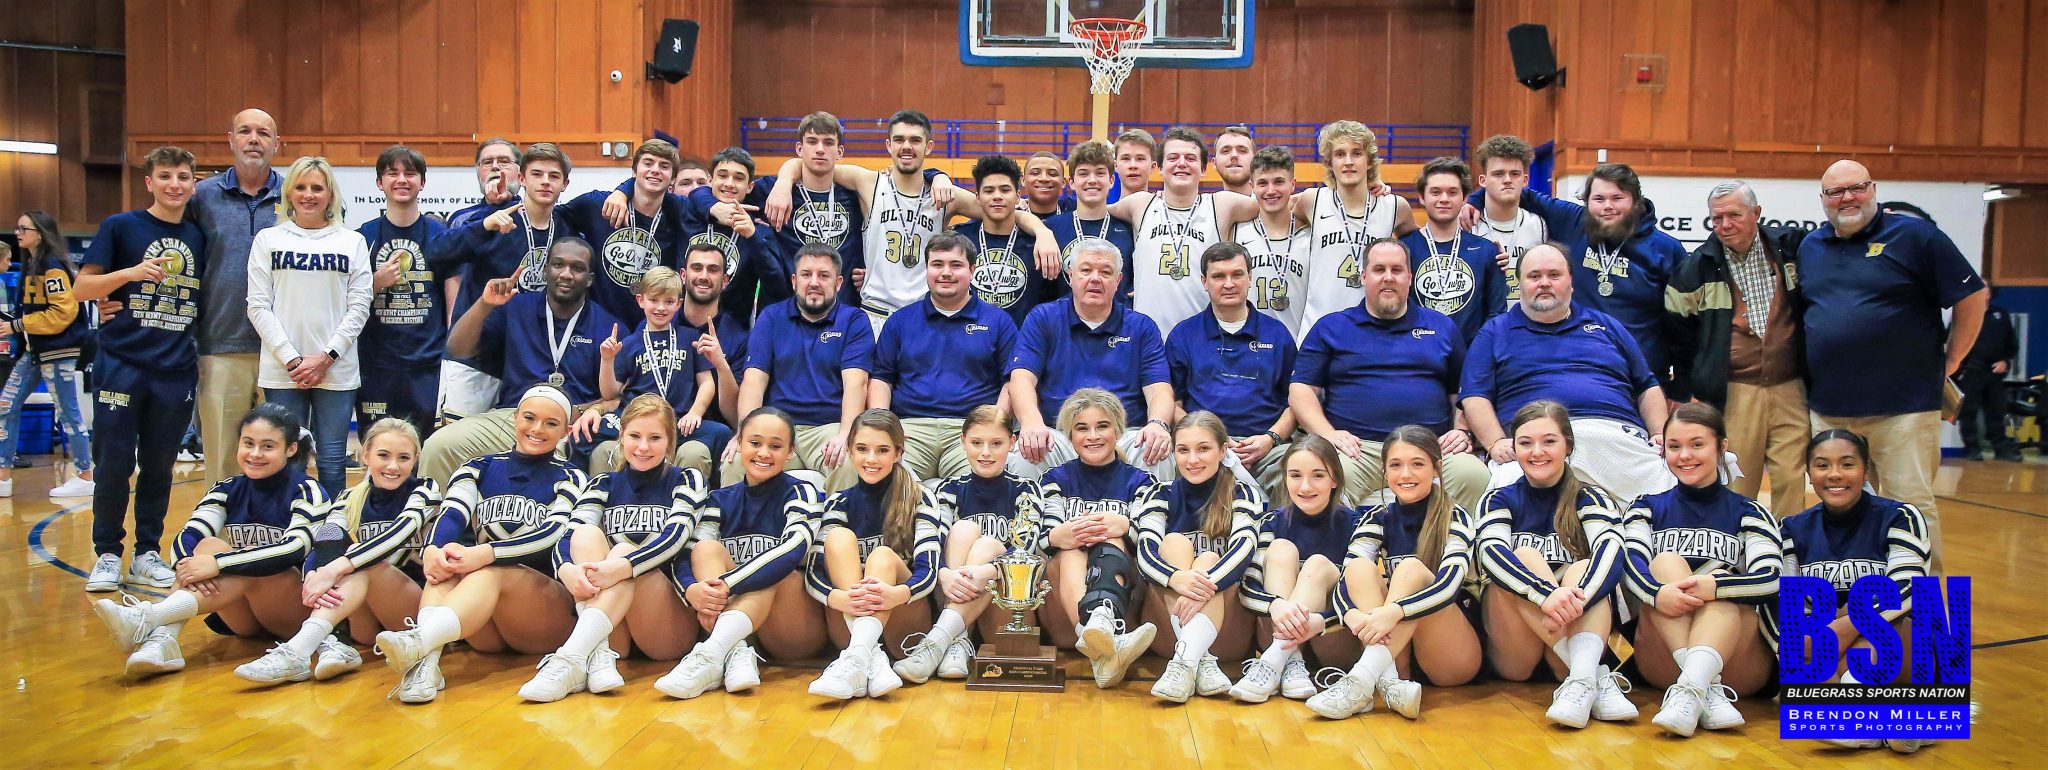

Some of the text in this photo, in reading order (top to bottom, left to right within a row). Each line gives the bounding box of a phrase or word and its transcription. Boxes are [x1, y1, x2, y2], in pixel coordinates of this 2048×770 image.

[369, 196, 387, 204] LOV
[880, 208, 934, 233] BULDGS
[1150, 222, 1205, 243] BULDGS
[271, 250, 349, 273] HAZARD
[610, 245, 624, 263] Go
[884, 230, 921, 268] 30
[1159, 243, 1190, 277] 21
[974, 269, 988, 286] Go
[1252, 254, 1304, 278] ULLDGS
[46, 277, 66, 293] 21
[1256, 277, 1289, 312] 13
[1422, 276, 1436, 294] Go
[476, 494, 552, 531] BULLDOG
[602, 504, 673, 537] HAZAR
[225, 523, 286, 549] AZAR
[1512, 532, 1576, 563] AZAR
[1651, 528, 1741, 566] HAZARD
[720, 534, 784, 565] AZAR
